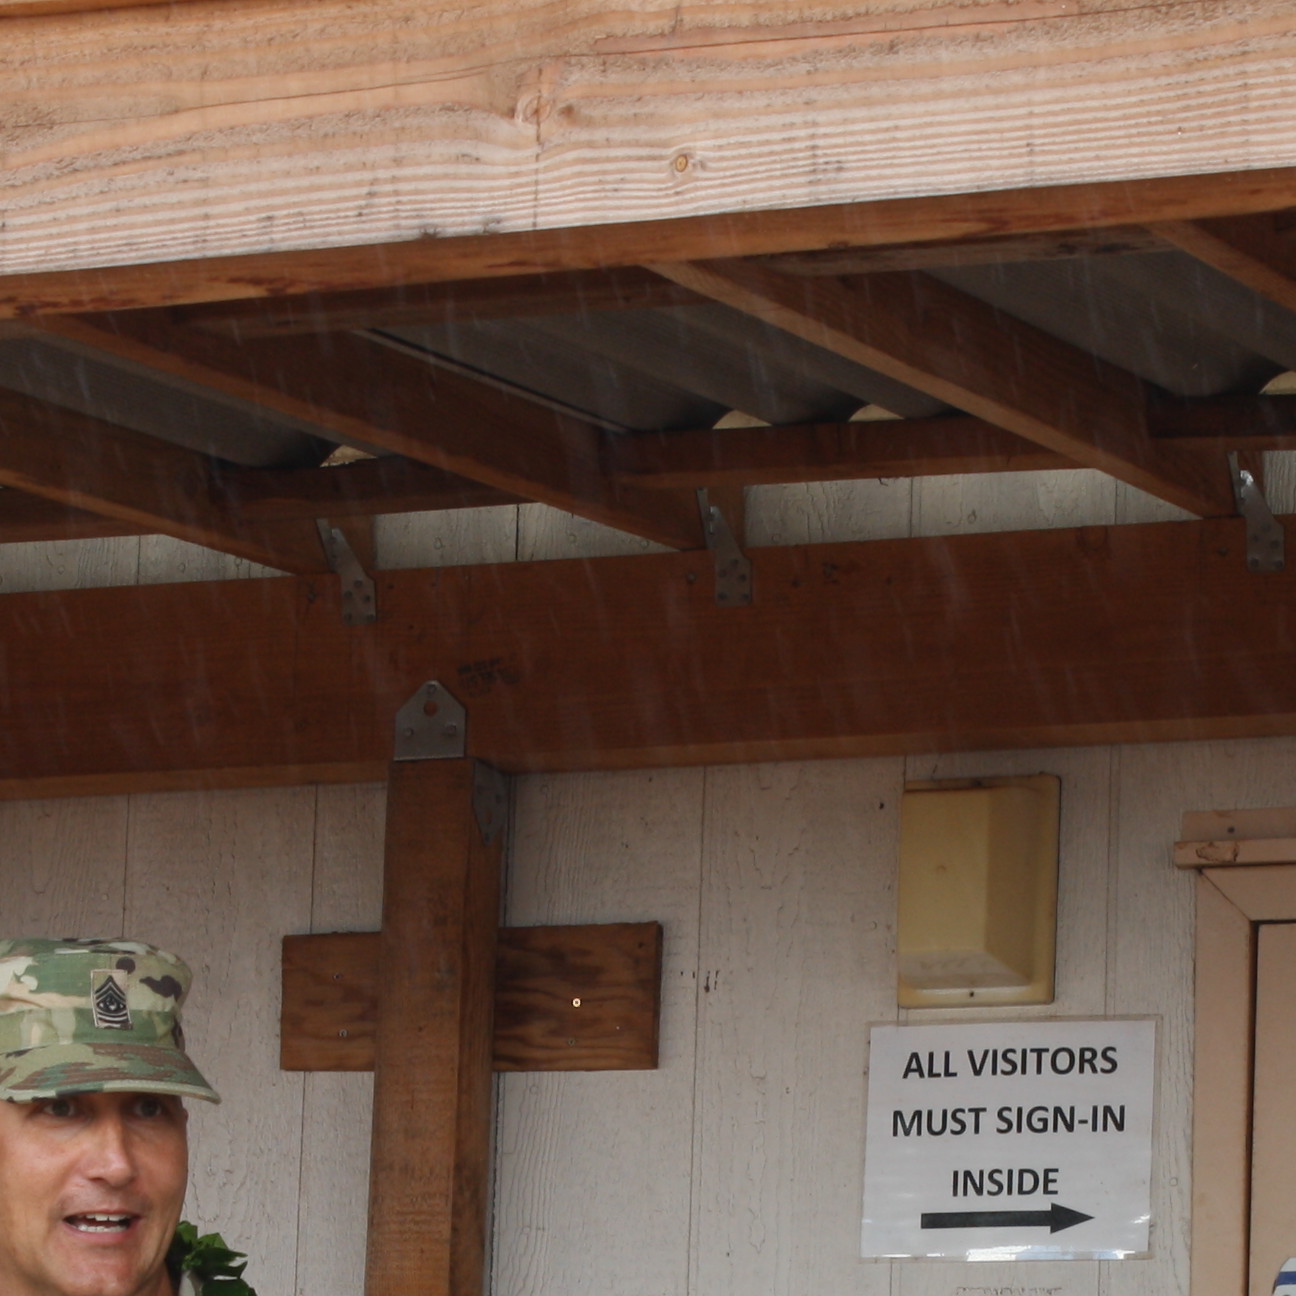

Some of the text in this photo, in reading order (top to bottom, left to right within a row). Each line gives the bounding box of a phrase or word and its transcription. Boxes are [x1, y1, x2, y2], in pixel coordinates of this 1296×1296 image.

[903, 1045, 1117, 1079] ALL VISITORS
[892, 1104, 1125, 1137] MUST SIGN-IN
[952, 1167, 1060, 1197] INSIDE
